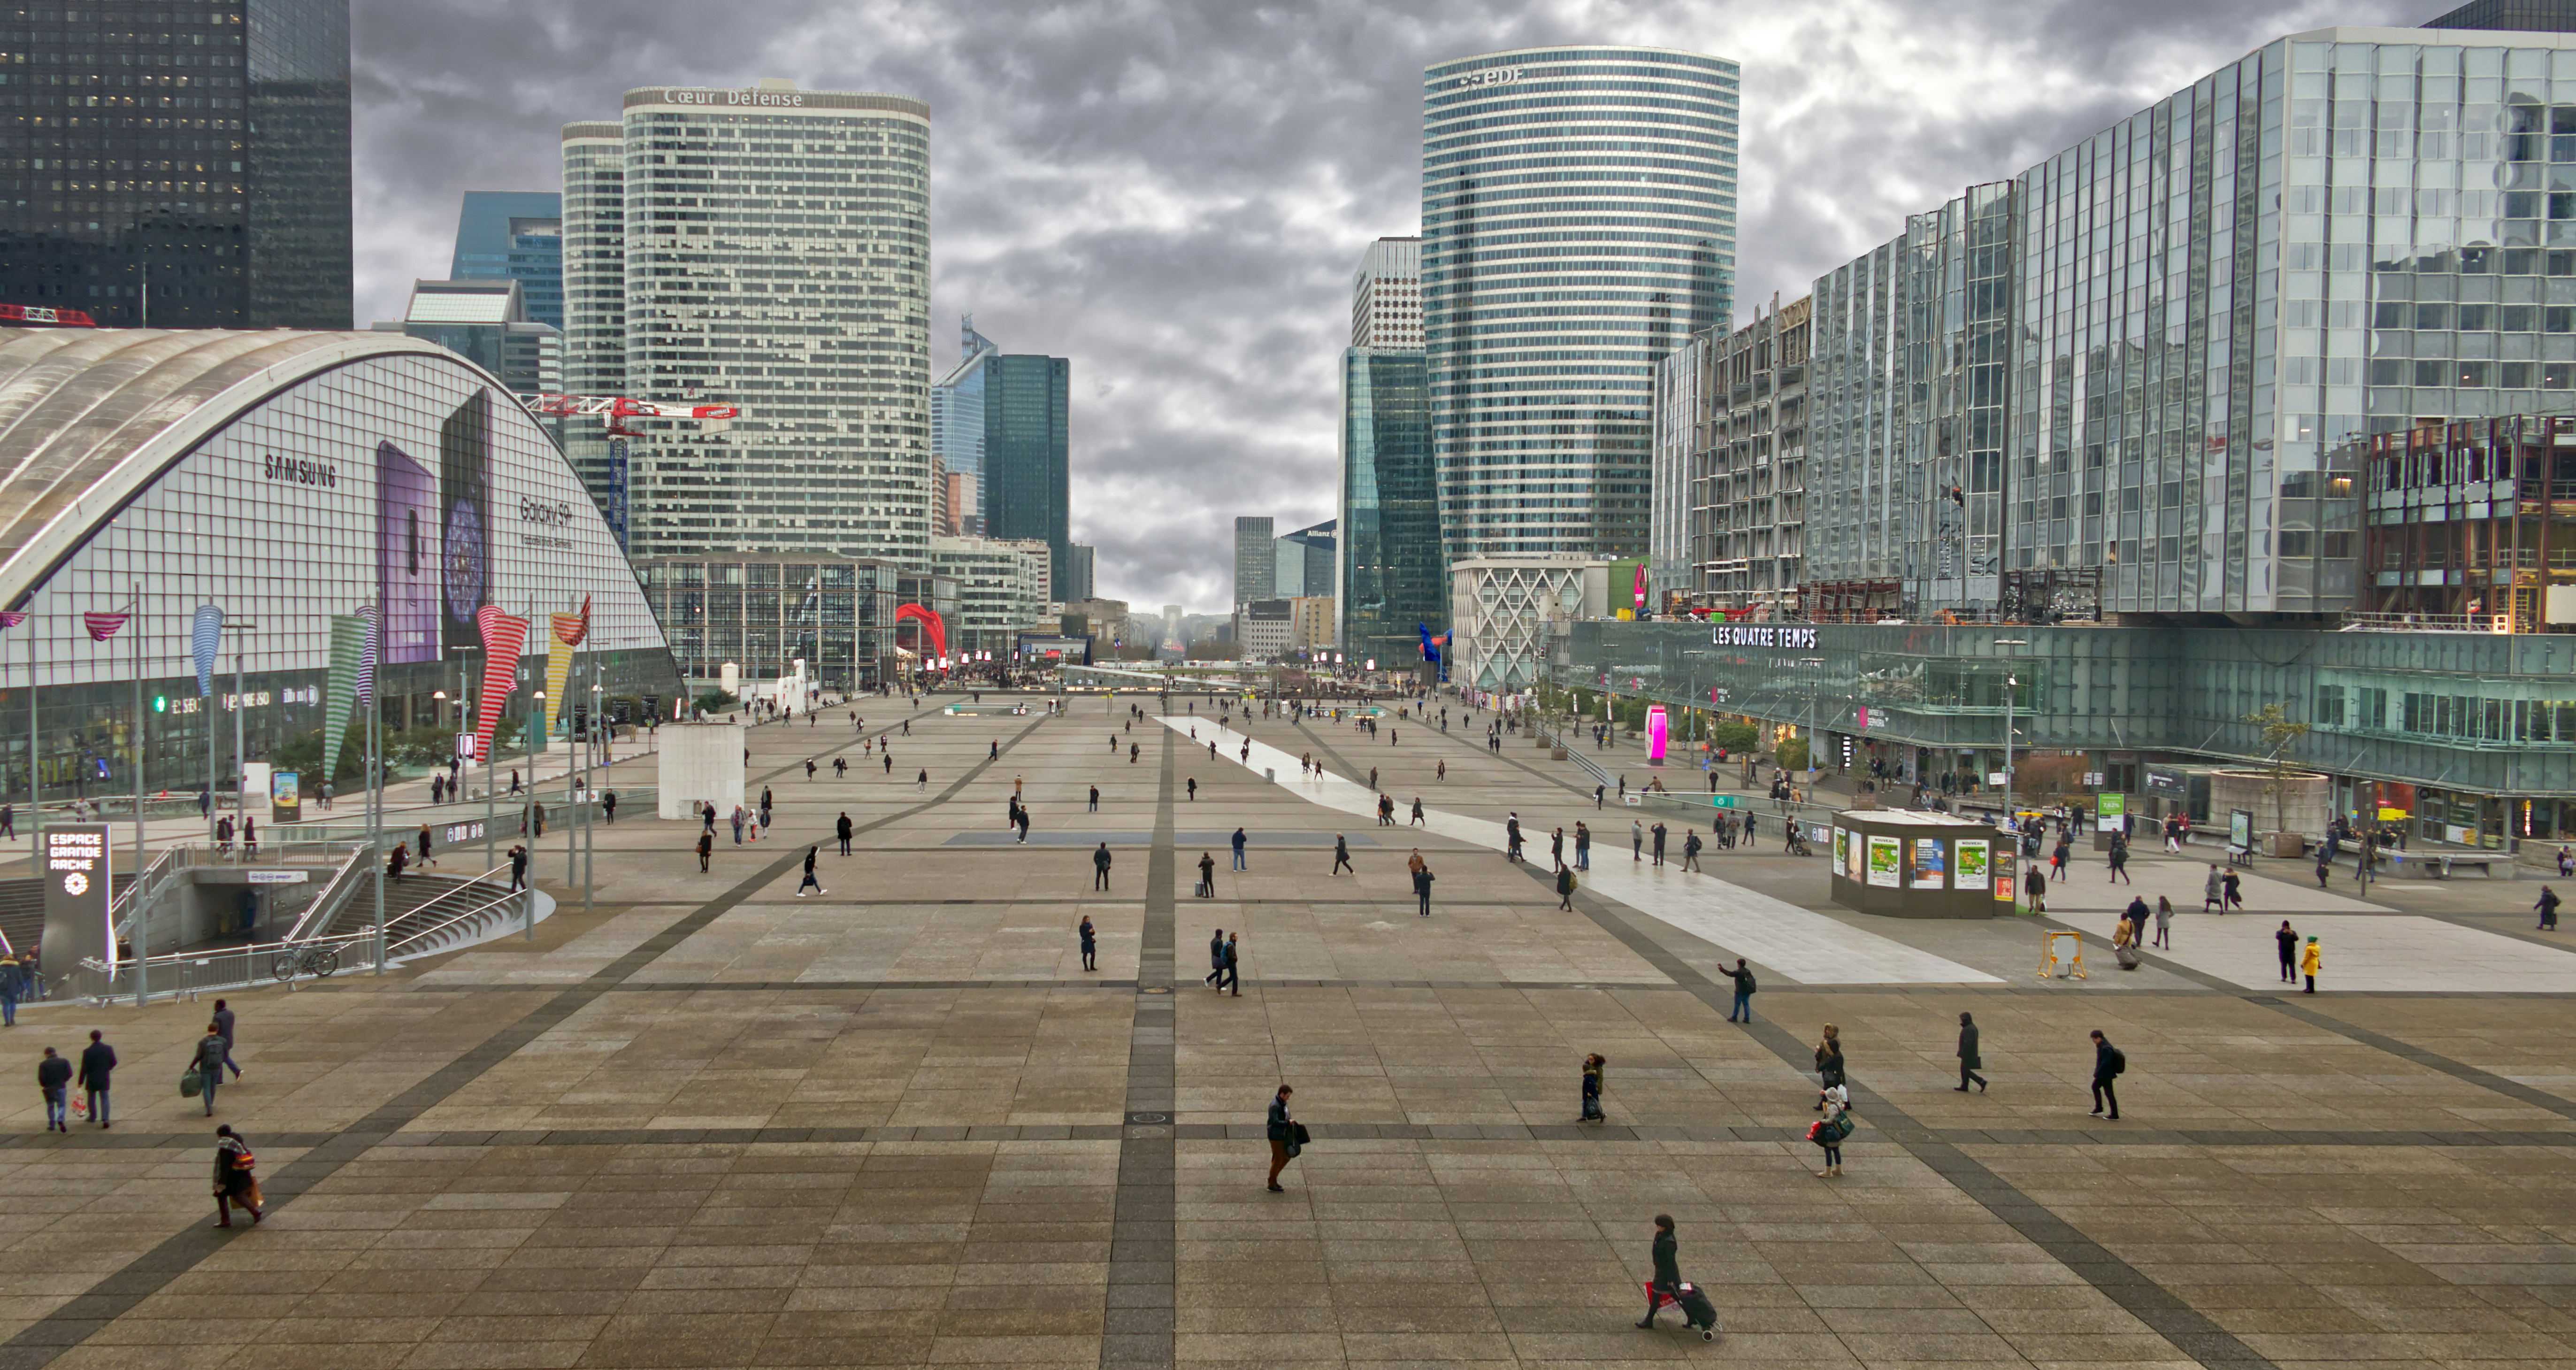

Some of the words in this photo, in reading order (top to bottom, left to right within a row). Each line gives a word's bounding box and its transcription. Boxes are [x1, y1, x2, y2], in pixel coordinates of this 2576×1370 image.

[665, 89, 715, 104] Cœur
[728, 89, 802, 106] Défense
[265, 454, 336, 488] SAMSUNG
[521, 497, 557, 531] Galaxy
[1713, 627, 1731, 645] LES
[1733, 627, 1774, 647] QUATRE
[1778, 628, 1817, 649] TEMPS
[50, 834, 101, 845] ESPACE
[50, 847, 101, 857] GRANDE
[50, 860, 93, 870] ARCHE
